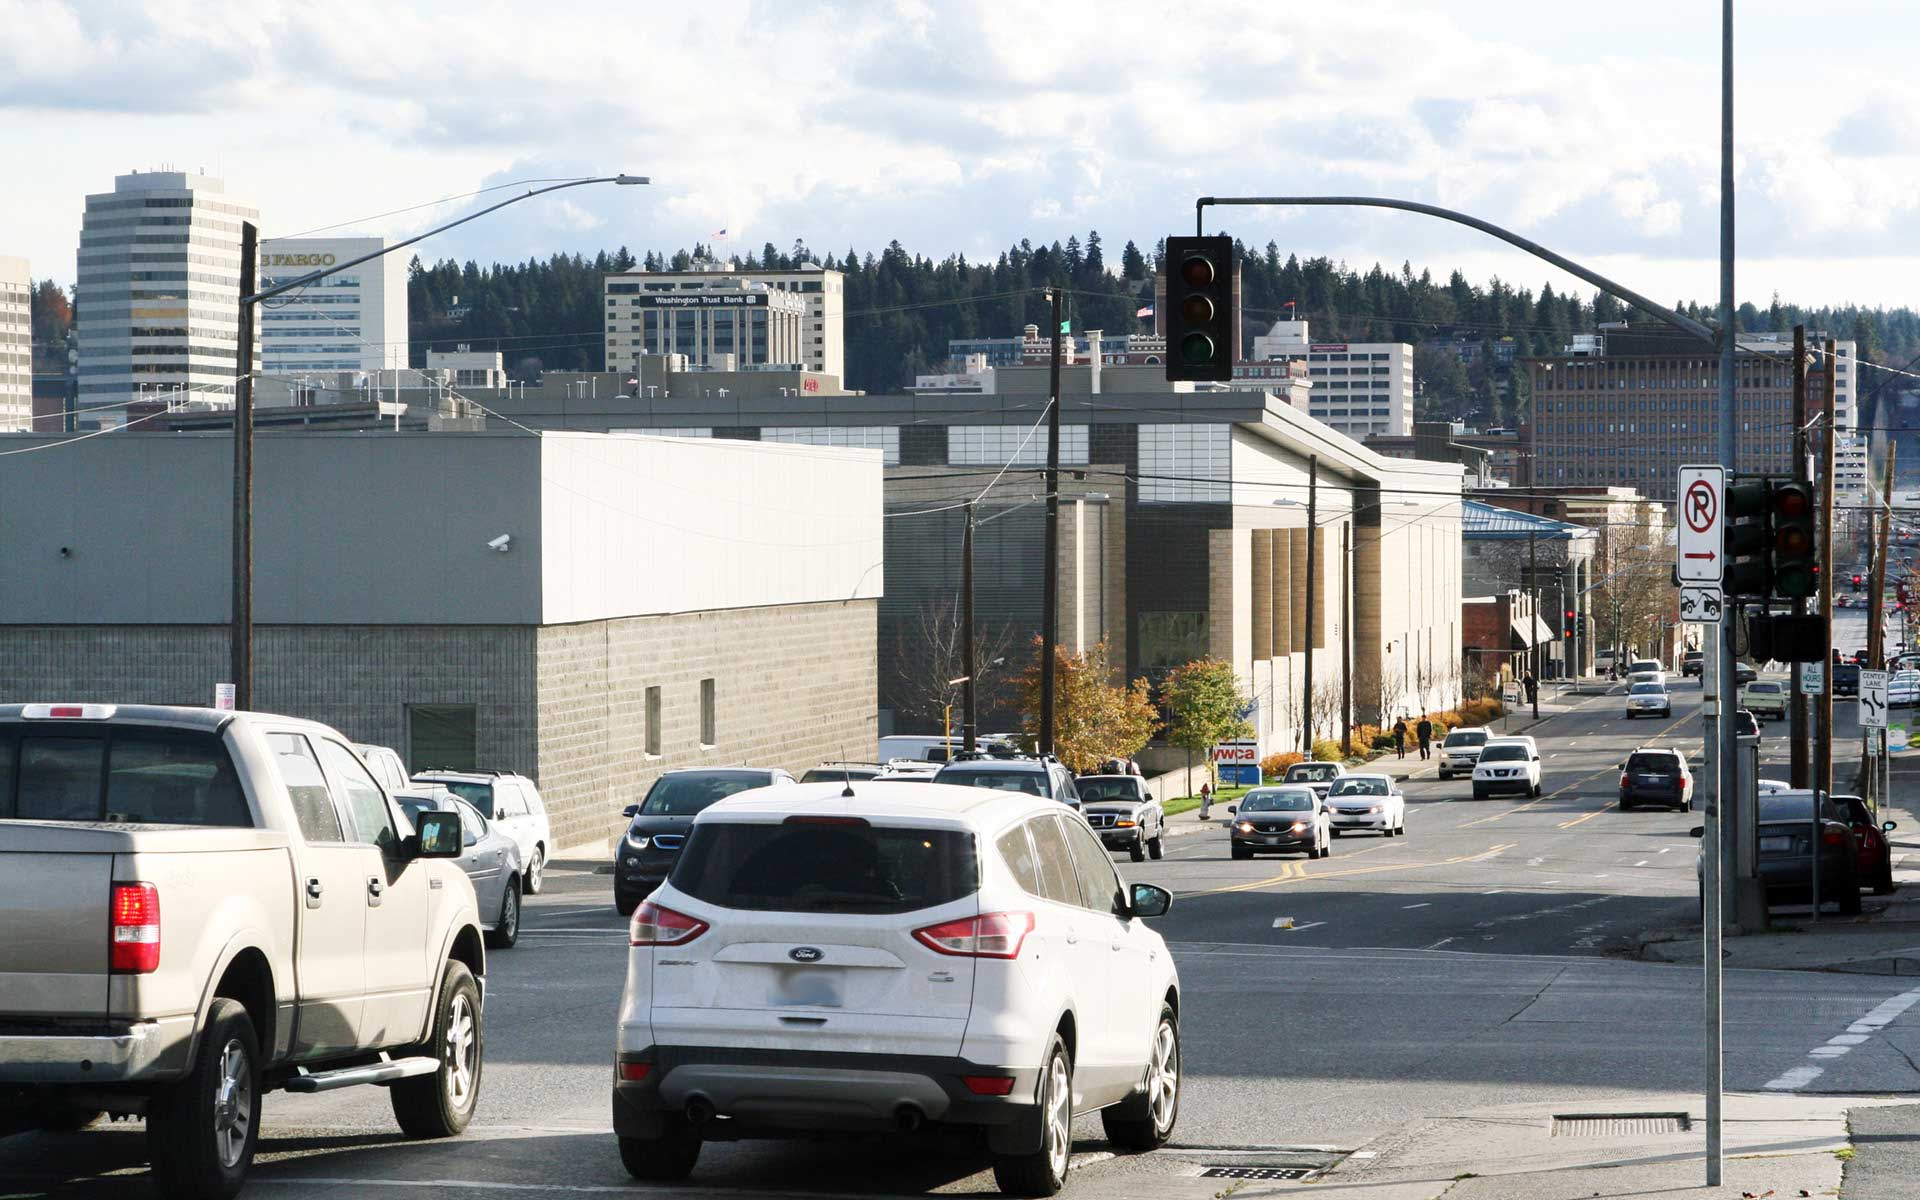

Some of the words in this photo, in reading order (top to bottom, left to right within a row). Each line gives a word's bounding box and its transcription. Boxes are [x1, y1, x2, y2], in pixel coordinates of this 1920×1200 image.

[271, 253, 335, 266] FARGO
[655, 296, 699, 306] Washington
[701, 296, 720, 304] Trust
[723, 296, 743, 304] Bank
[1693, 490, 1709, 522] P
[1807, 665, 1817, 673] ALL
[1213, 748, 1255, 761] ywca
[796, 950, 816, 959] Ford
